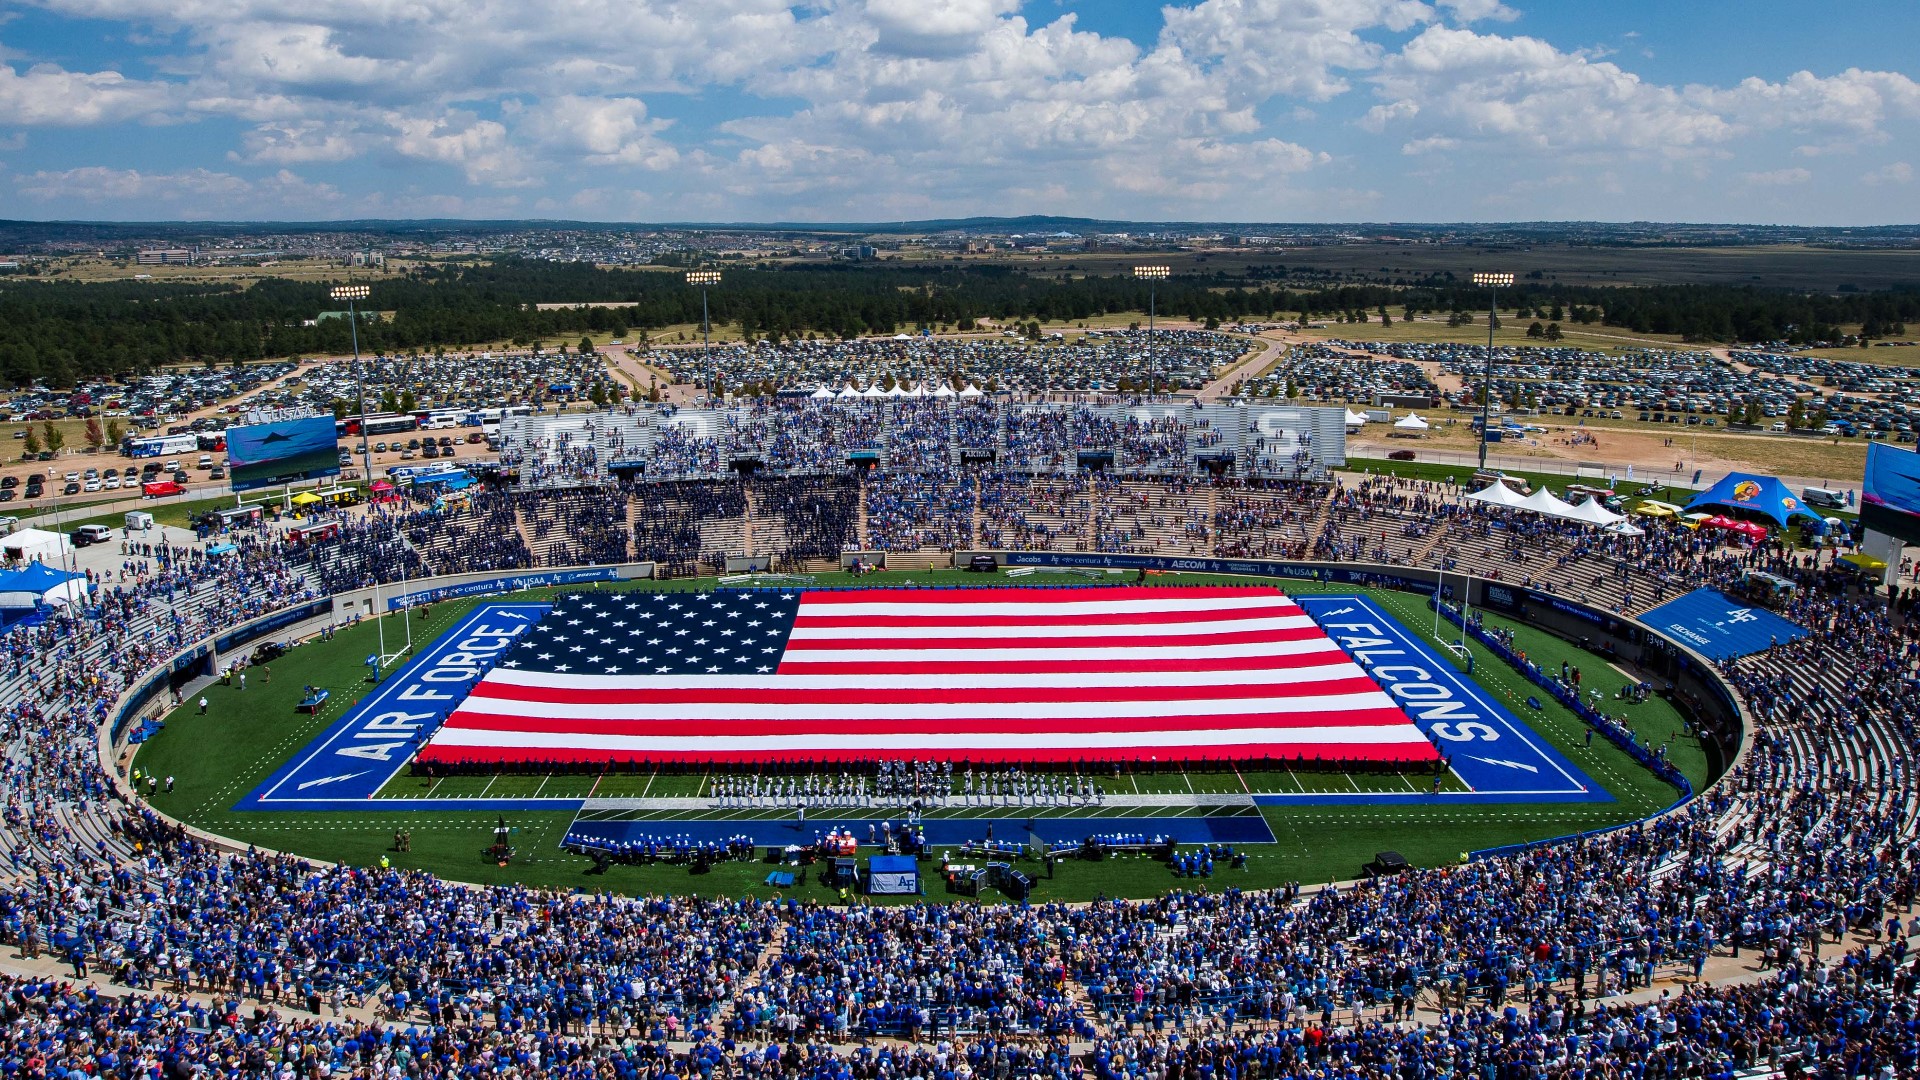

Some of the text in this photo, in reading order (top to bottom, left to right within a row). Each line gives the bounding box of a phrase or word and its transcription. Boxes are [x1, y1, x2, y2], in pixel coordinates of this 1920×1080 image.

[965, 450, 991, 458] AKIMA
[1016, 555, 1041, 563] Jacobs
[1171, 560, 1206, 569] AECOM
[523, 576, 545, 585] USAA
[464, 583, 493, 592] centura
[1670, 623, 1711, 645] EXCHANGE
[397, 624, 527, 700] FORCE
[1324, 623, 1500, 742] FALCONS
[335, 711, 436, 761] AIR
[898, 875, 914, 891] AF
